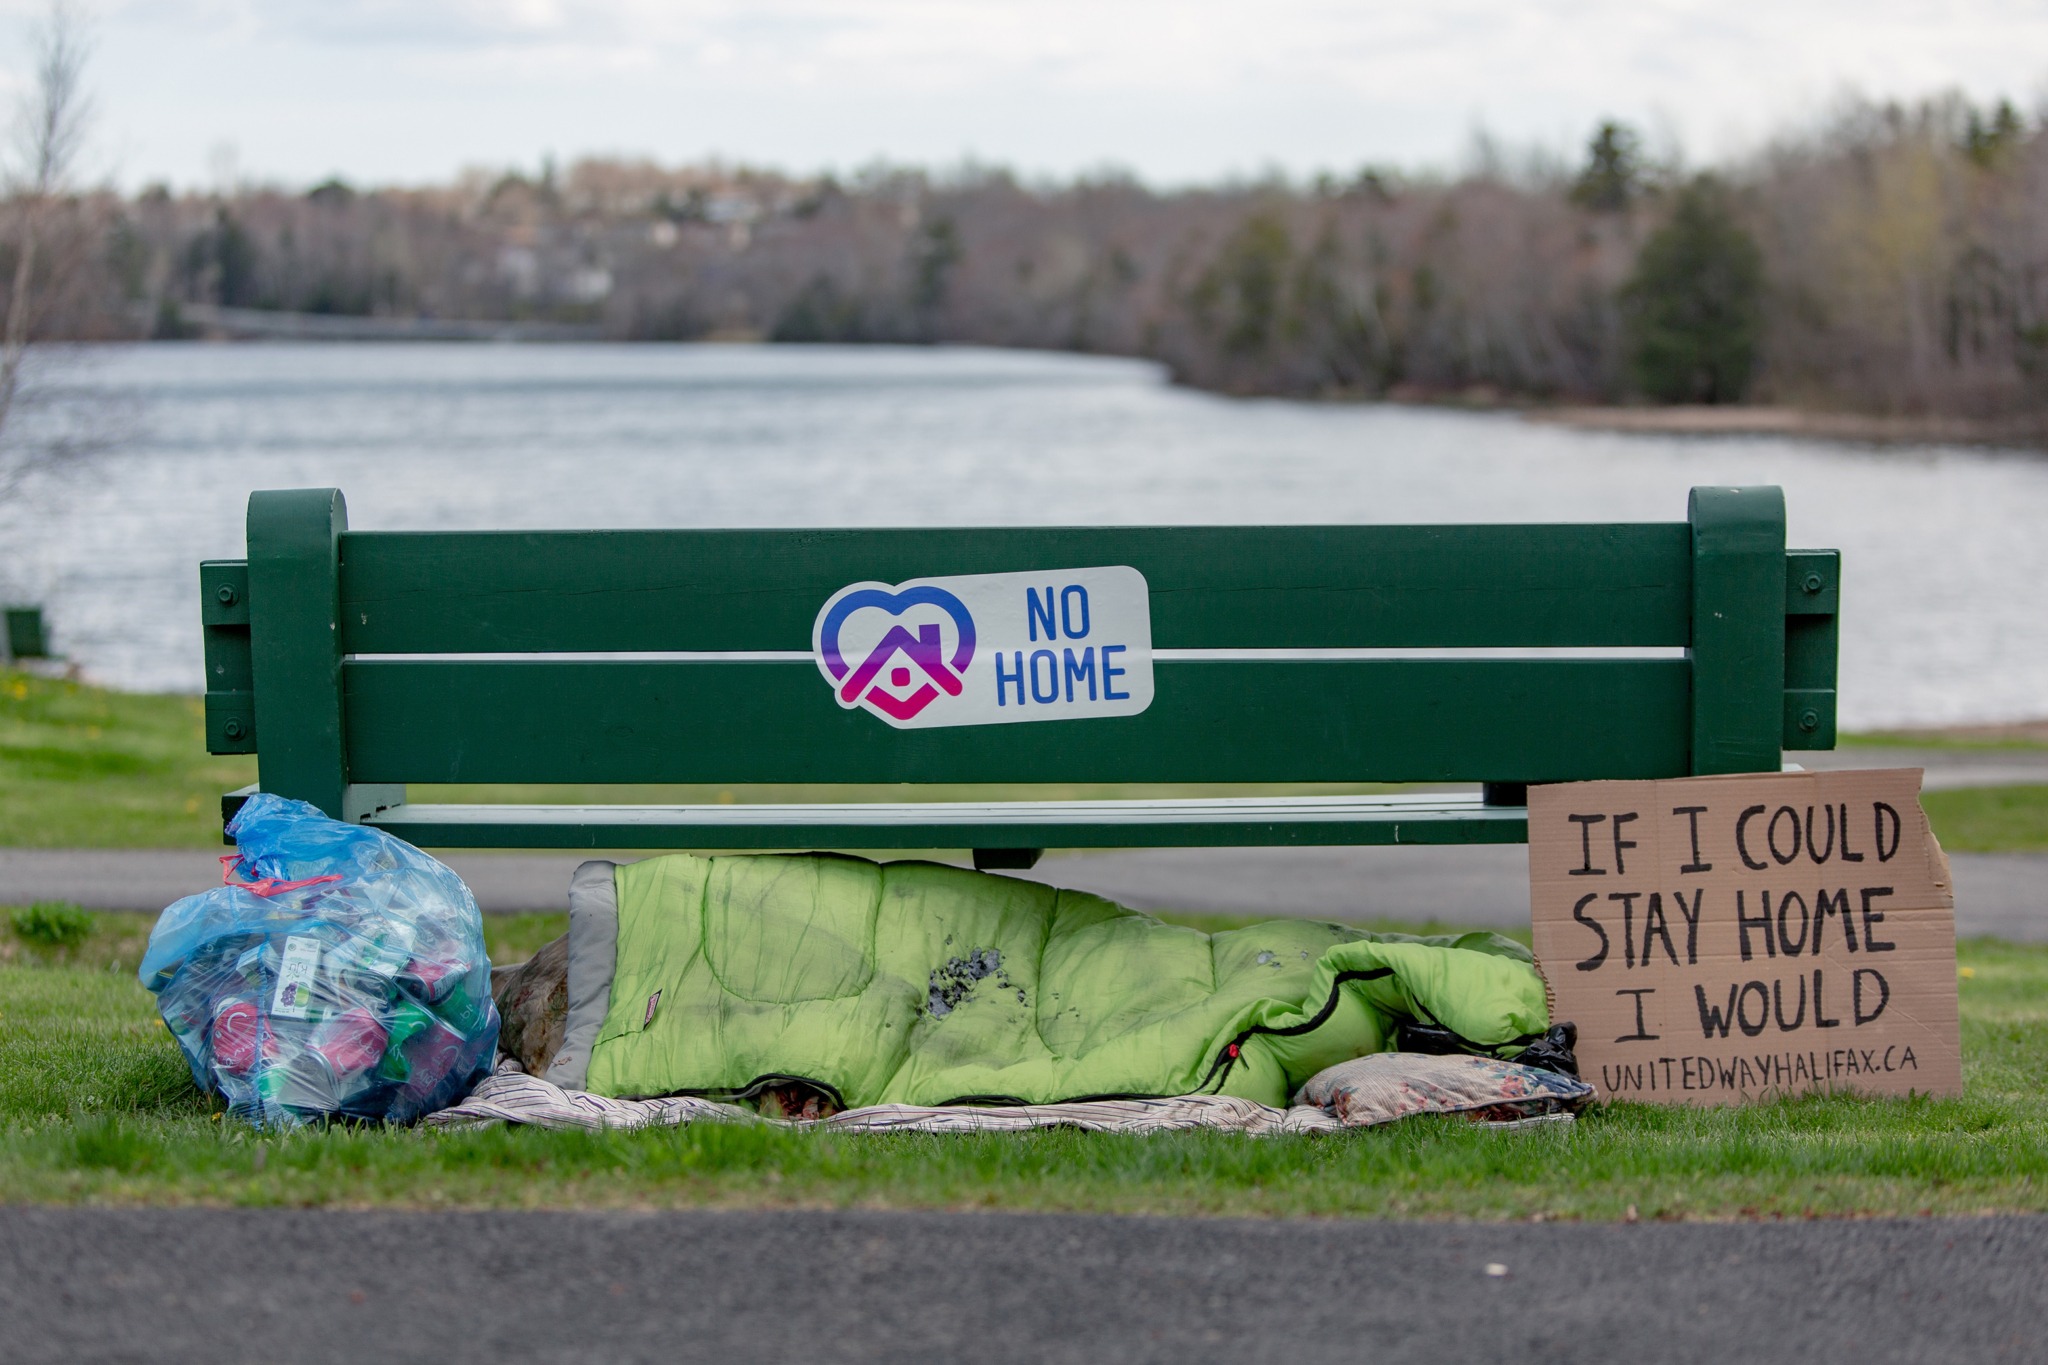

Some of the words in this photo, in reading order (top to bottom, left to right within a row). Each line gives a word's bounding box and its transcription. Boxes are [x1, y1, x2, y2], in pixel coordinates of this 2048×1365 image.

[1026, 584, 1090, 642] NO
[995, 644, 1130, 707] HOME
[1568, 812, 1639, 875] IF
[1672, 806, 1713, 873] I
[1735, 802, 1902, 870] COULD
[1573, 888, 1705, 972] STAY
[1736, 887, 1897, 962] HOME
[1614, 988, 1660, 1043] I
[1694, 968, 1890, 1040] WOULD
[1602, 1045, 1918, 1092] UNITEDWAYHALIFAX.CA
